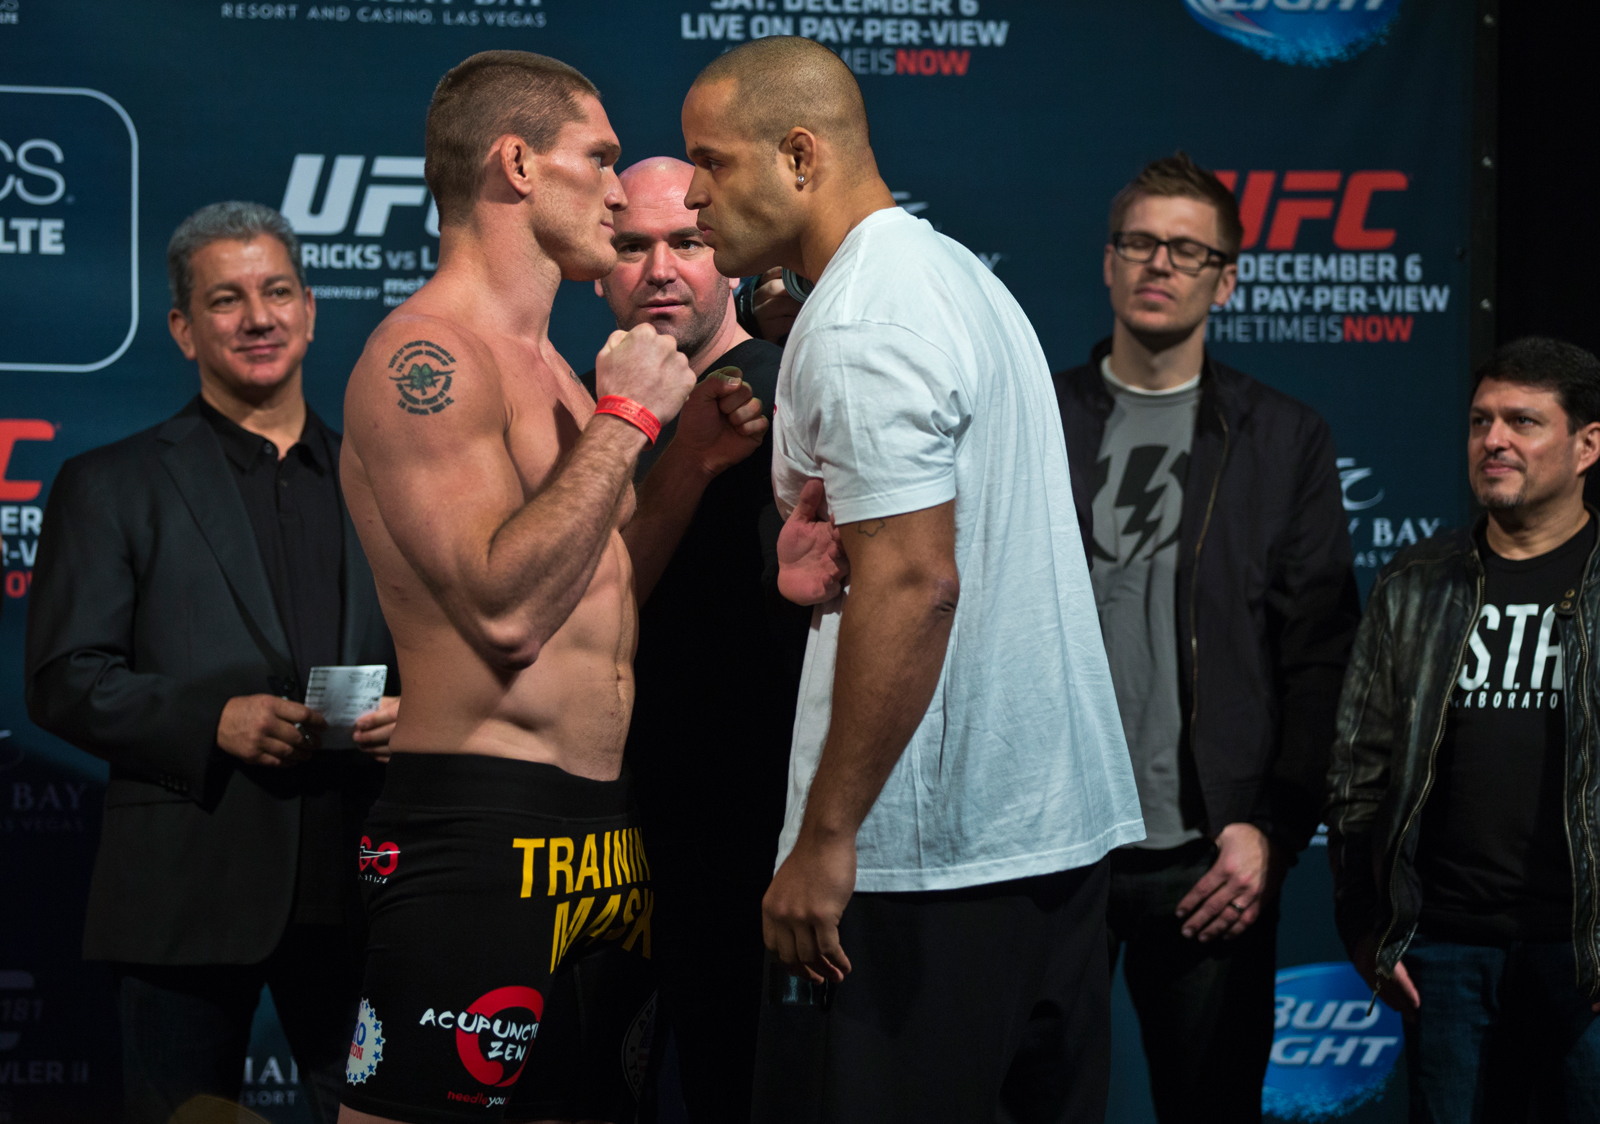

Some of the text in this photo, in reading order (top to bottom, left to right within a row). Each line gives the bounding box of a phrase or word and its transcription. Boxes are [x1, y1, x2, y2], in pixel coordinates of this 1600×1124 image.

[220, 2, 299, 20] RESORT
[306, 5, 351, 22] AND
[443, 10, 480, 26] LAS
[483, 11, 547, 28] VEGAS
[681, 12, 1010, 47] LIVE ON PAY-PER-VIEW
[279, 153, 440, 237] UF
[1237, 253, 1423, 283] DECEMBER 6
[1252, 285, 1450, 313] PAY-PER-VIEW
[1372, 517, 1441, 547] BAY
[13, 782, 87, 811] BAY
[550, 887, 654, 974] MASK
[488, 1041, 526, 1061] ZEN
